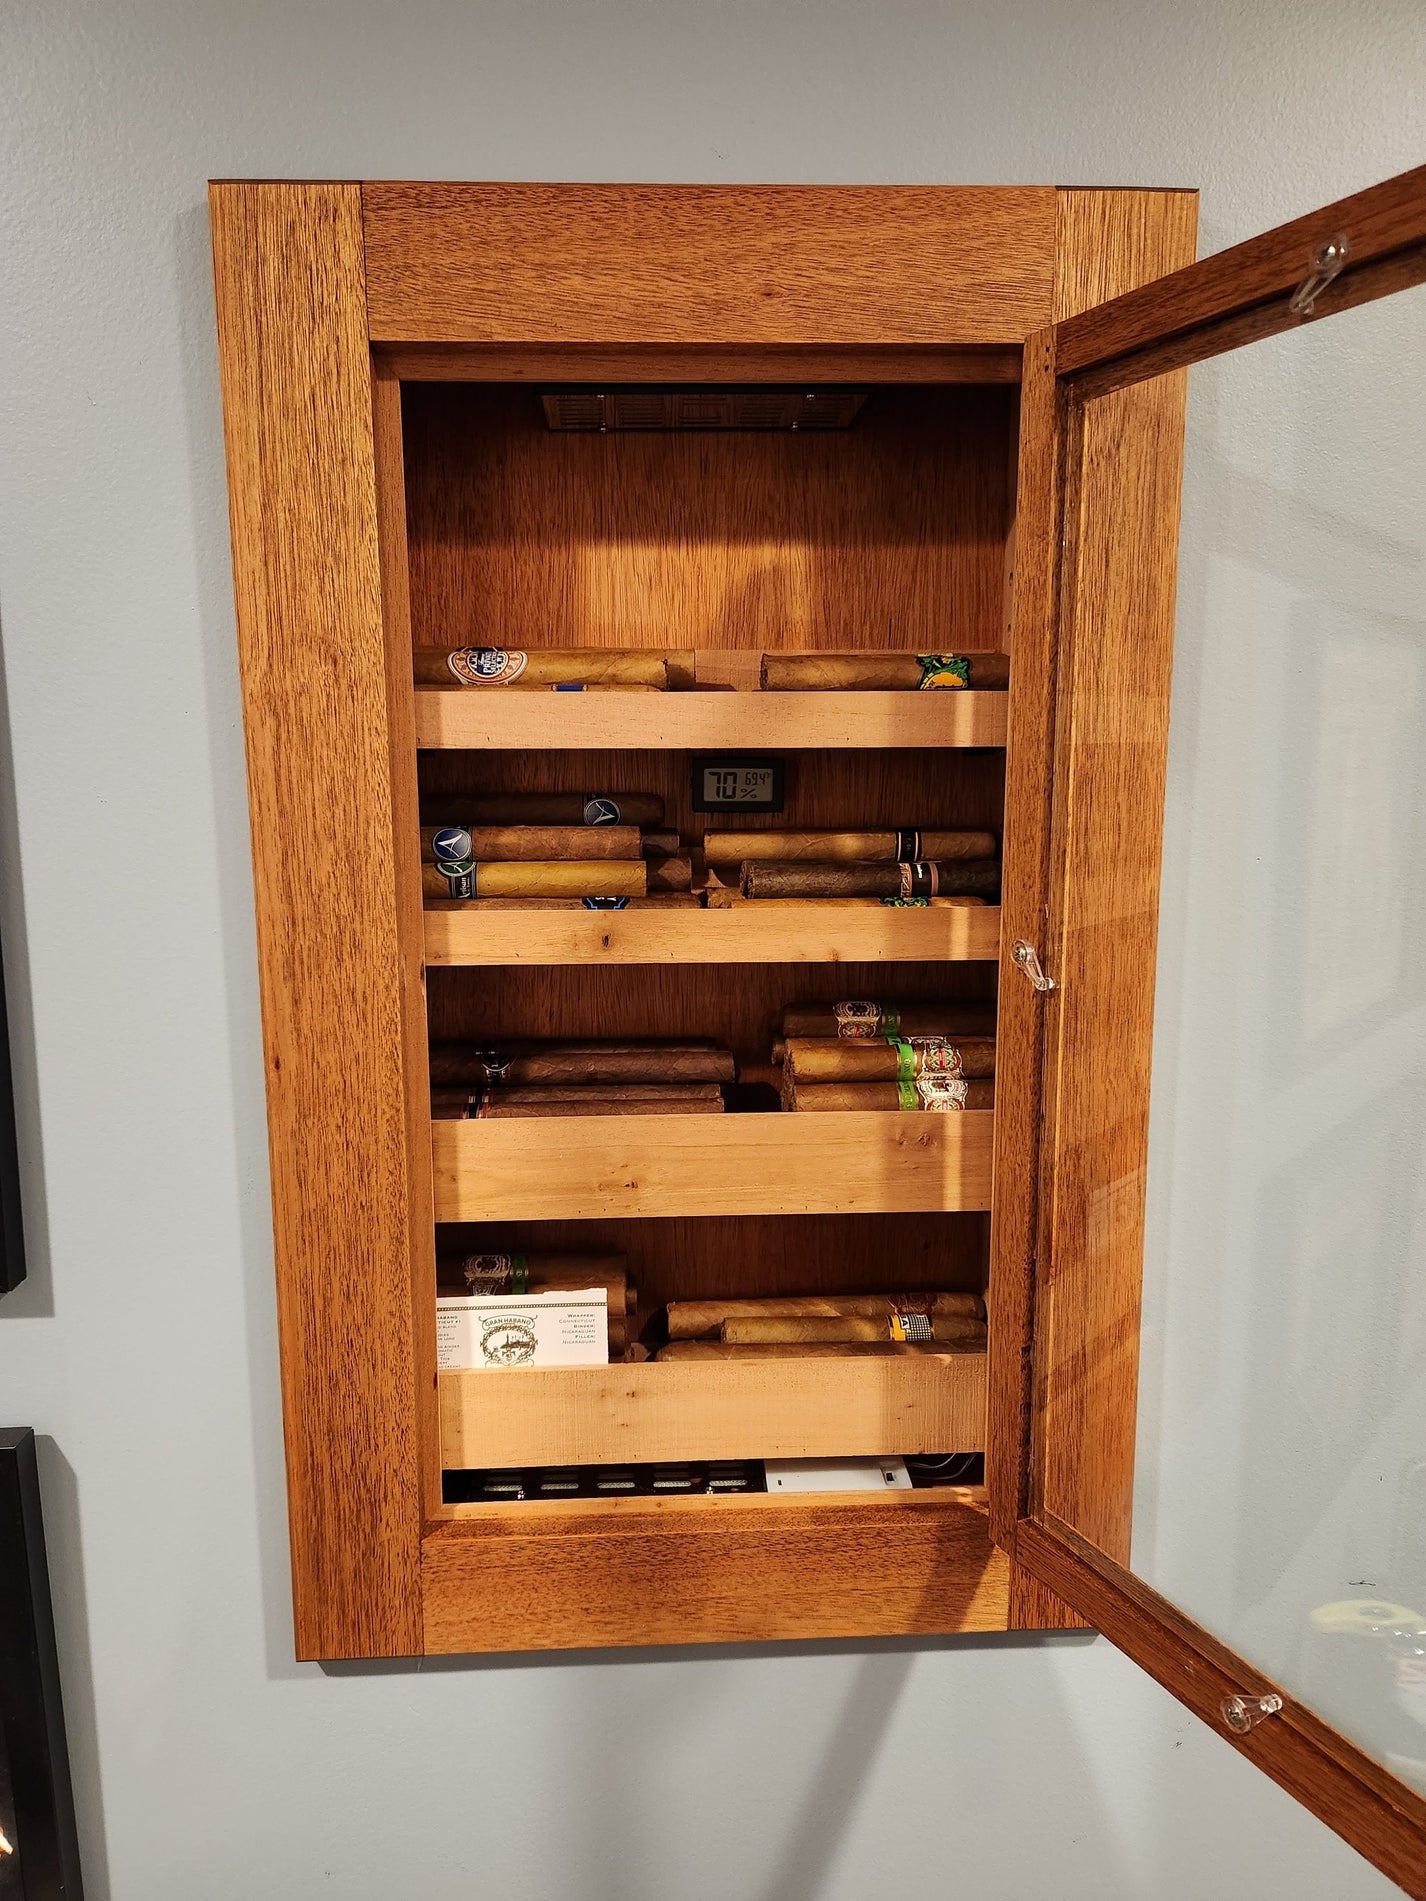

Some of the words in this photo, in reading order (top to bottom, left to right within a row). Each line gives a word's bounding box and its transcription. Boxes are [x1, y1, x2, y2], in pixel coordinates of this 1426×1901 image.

[708, 772, 737, 799] 70
[485, 1318, 503, 1327] GRAN
[504, 1318, 532, 1326] HABANO
